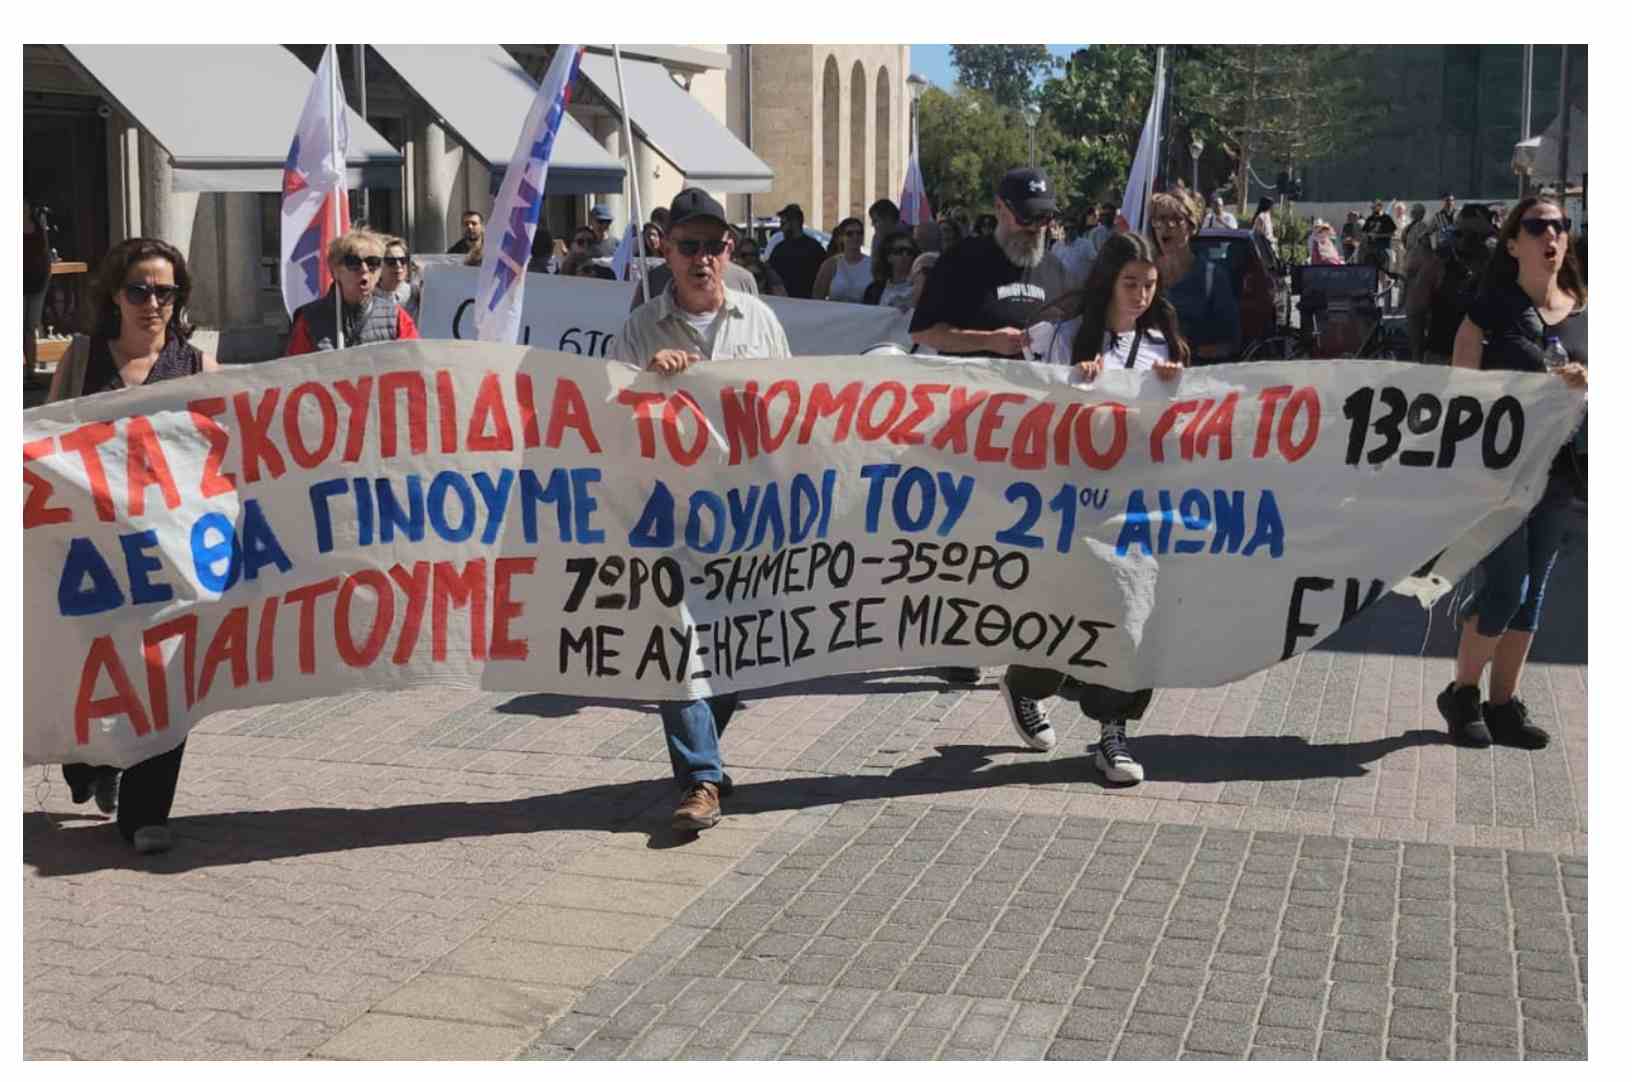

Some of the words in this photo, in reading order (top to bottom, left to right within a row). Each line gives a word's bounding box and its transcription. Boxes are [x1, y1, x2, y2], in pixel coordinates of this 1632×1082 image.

[23, 415, 180, 529] ΣΤΑ
[186, 369, 603, 498] ΣΚΟΥΠΙΔΙΑ
[617, 388, 709, 470] ΤΟ
[721, 378, 1127, 471] ΝΟΜΟΣΧΕΔΙΟ
[1149, 391, 1242, 466] ΓΙΑ
[1252, 384, 1321, 463] ΤΟ
[1342, 384, 1524, 469] 13ΩΡΟ
[58, 530, 171, 617] ΔΕ
[190, 498, 293, 594] ΘΑ
[309, 467, 606, 554] ΓΙΝΟΥΜΕ
[628, 469, 837, 555] ΔΟΥΛΟΙ
[860, 463, 975, 538] ΤΟΥ
[1115, 488, 1286, 558] ΑΙΩΝΑ
[74, 556, 536, 746] ΑΠΑΙΤΟΥΜΕ
[558, 625, 624, 679] ΜΕ
[635, 606, 816, 684] ΑΥΞΗΣΕΙΣ
[828, 596, 886, 653] ΣΕ
[898, 594, 1116, 668] ΜΙΣΘΟΥΣ
